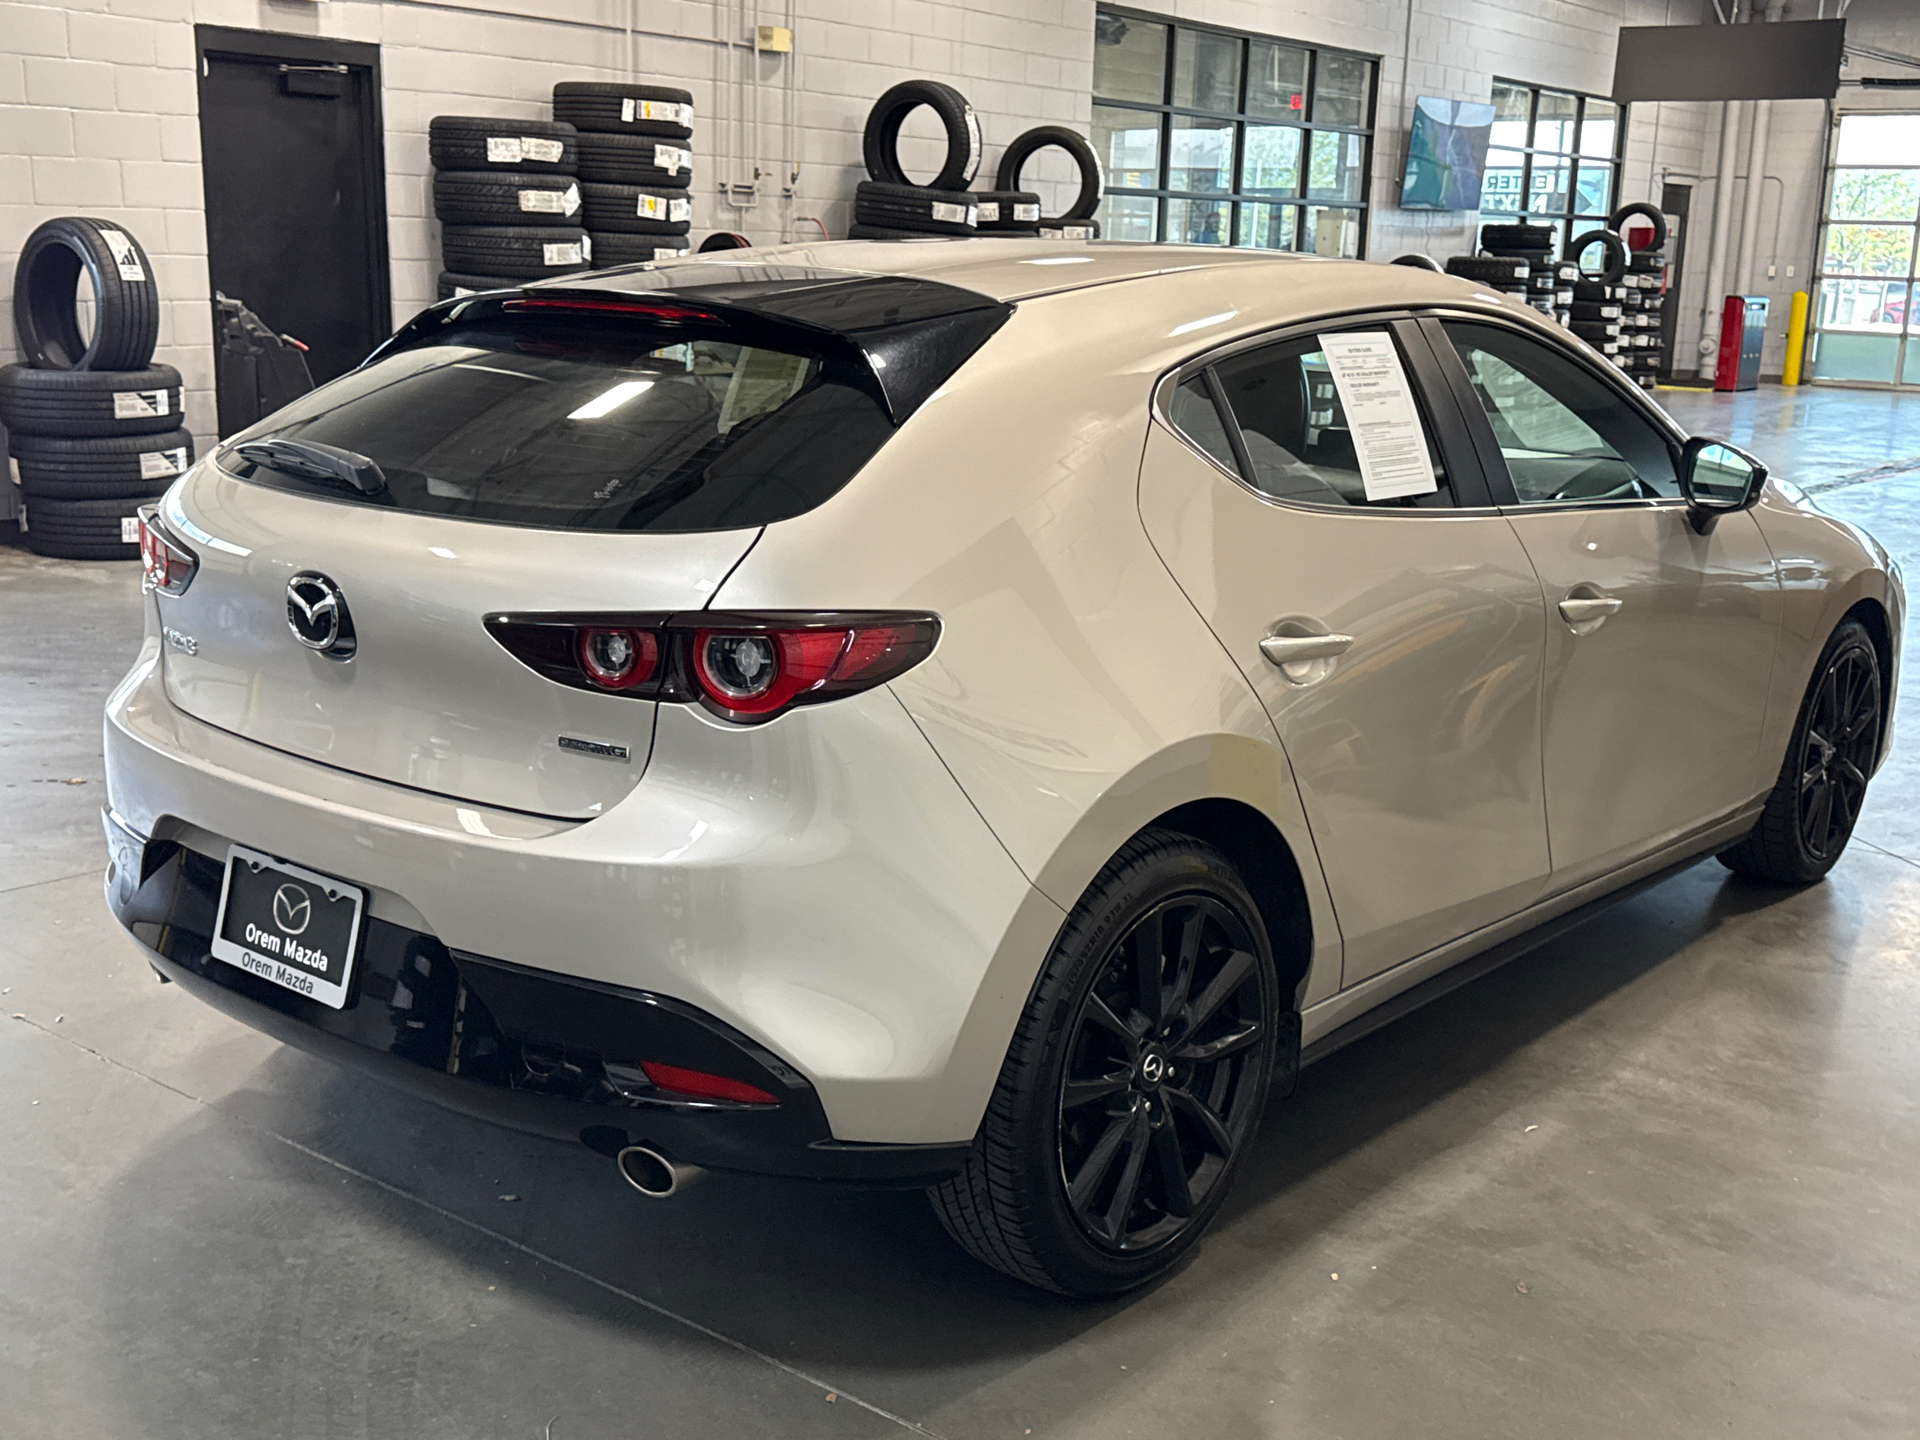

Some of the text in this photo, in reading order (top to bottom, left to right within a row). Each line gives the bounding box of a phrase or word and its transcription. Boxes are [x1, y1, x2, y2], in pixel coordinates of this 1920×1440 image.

[245, 923, 328, 972] Orem Mazda
[241, 951, 314, 994] Orem Mazda
